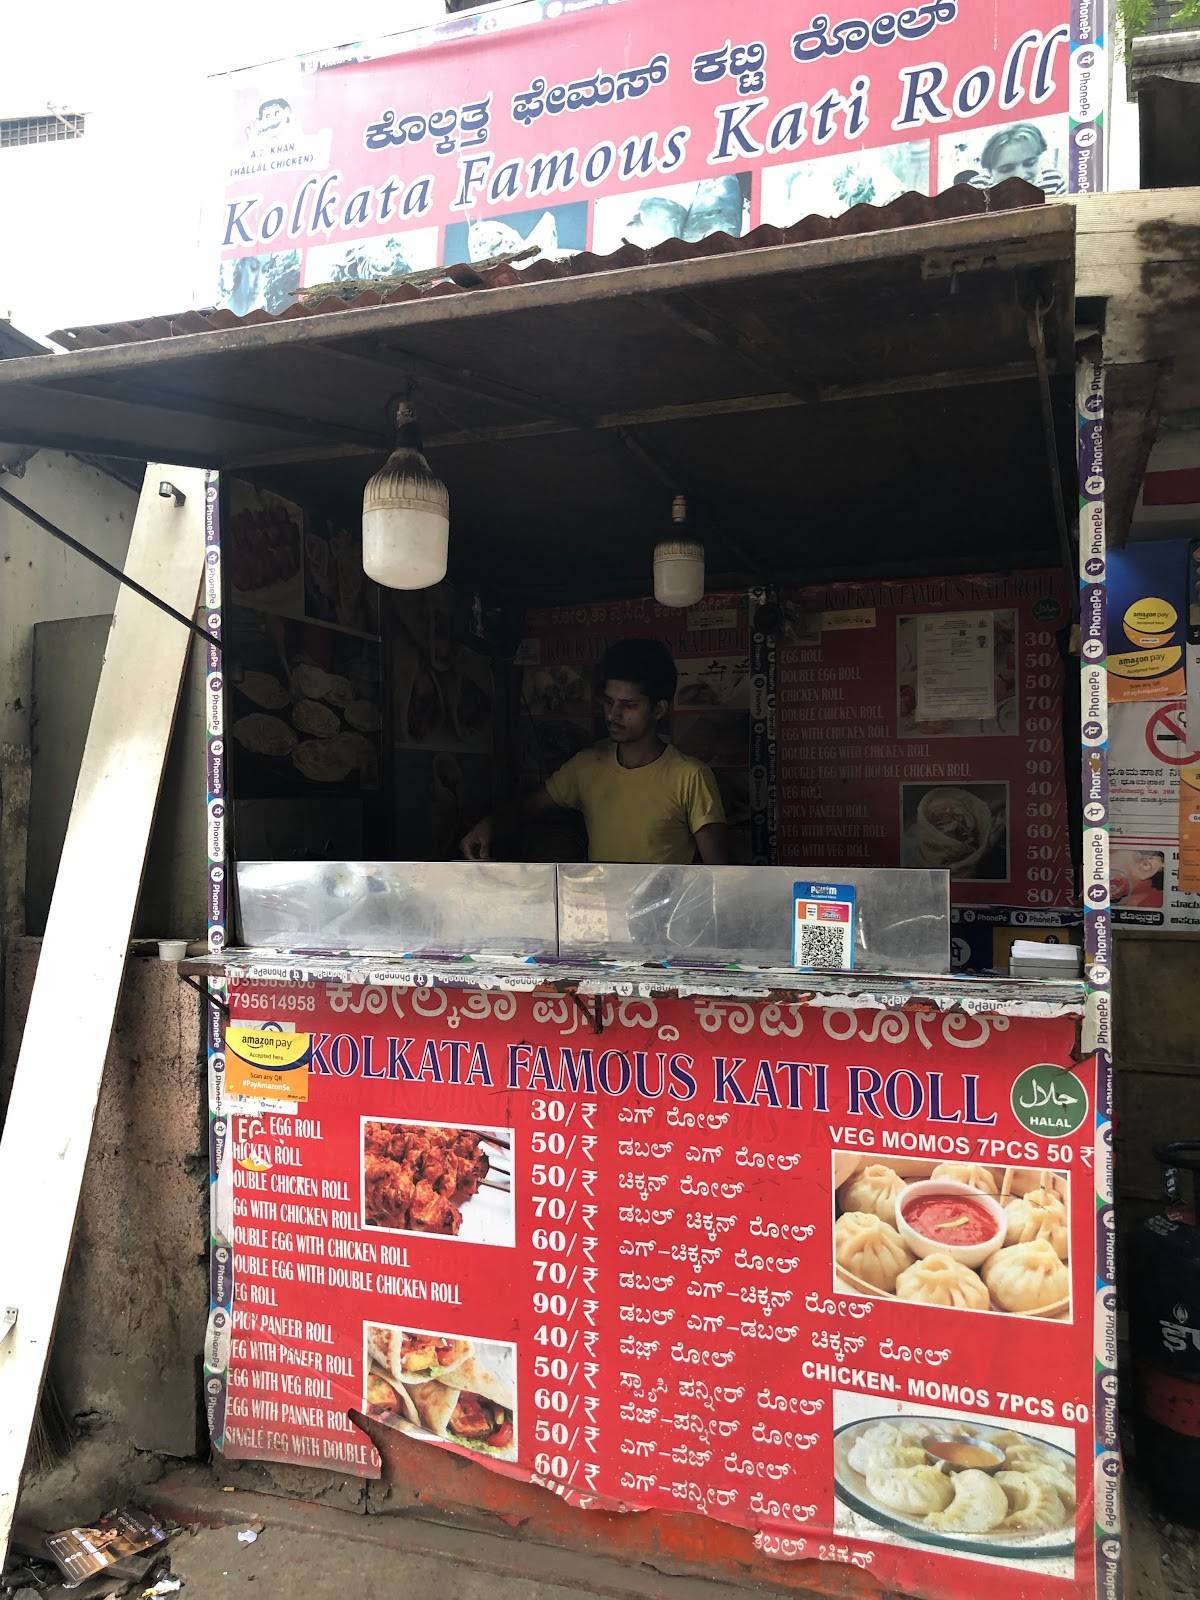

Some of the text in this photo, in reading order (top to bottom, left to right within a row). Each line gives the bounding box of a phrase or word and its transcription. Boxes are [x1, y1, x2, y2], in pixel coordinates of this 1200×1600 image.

[1080, 72, 1090, 116] PhonePe
[223, 30, 1068, 246] Kolkata Famous Kati Roll
[270, 143, 295, 154] KHAN
[1091, 425, 1102, 474] PhonePe
[206, 504, 214, 541] PhonePe
[1091, 507, 1102, 555] PhonePe
[1090, 588, 1102, 637] PhonePe
[1119, 653, 1165, 666] amazon pay
[1088, 670, 1100, 718] PhonePe
[213, 757, 221, 794] PhonePe
[213, 821, 221, 857] PhonePe
[1092, 834, 1103, 881] PhonePe
[212, 884, 221, 921] PhonePe
[977, 914, 1009, 923] PhonePe
[1028, 916, 1060, 924] PhonePe
[1094, 915, 1106, 963] PhonePe
[253, 968, 287, 978] PhonePe
[1097, 997, 1109, 1044] PhonePe
[242, 1036, 293, 1049] amazon pay
[249, 1052, 272, 1060] Accepted
[305, 1032, 999, 1127] KOLKATA FAMOUS KATI ROLL
[1019, 1077, 1079, 1109] حلال
[270, 1116, 291, 1137] EGG
[295, 1118, 323, 1140] ROLL
[1029, 1116, 1072, 1128] HALAL
[275, 1146, 302, 1167] ROLL
[829, 1125, 875, 1147] VEG
[882, 1130, 970, 1155] MOMOS
[976, 1138, 1040, 1161] 7PCS
[1046, 1144, 1073, 1164] 50
[271, 1174, 350, 1201] CHICKEN ROLL
[250, 1199, 361, 1231] WITH CHICKEN ROLL
[272, 1231, 411, 1268] EGG WITH CHICKEN ROLL
[217, 1265, 225, 1302] PhonePe
[251, 1284, 278, 1306] ROLL
[272, 1259, 462, 1304] EGG WITH DOUBLE CHICKEN ROLL
[261, 1314, 334, 1344] PANEER ROLL
[250, 1341, 355, 1377] WITH ROLL
[251, 1369, 333, 1400] WITH VEG ROLL
[802, 1360, 1089, 1423] CHICKEN- MOMOS 7PCS 60
[251, 1398, 278, 1421] WITH
[281, 1403, 324, 1429] PANNER
[327, 1410, 356, 1434] ROLL
[1105, 1398, 1115, 1446] PhonePe
[225, 1426, 367, 1466] SINGLE EGG WITH DOUBLE
[1105, 1480, 1117, 1528] PhonePe
